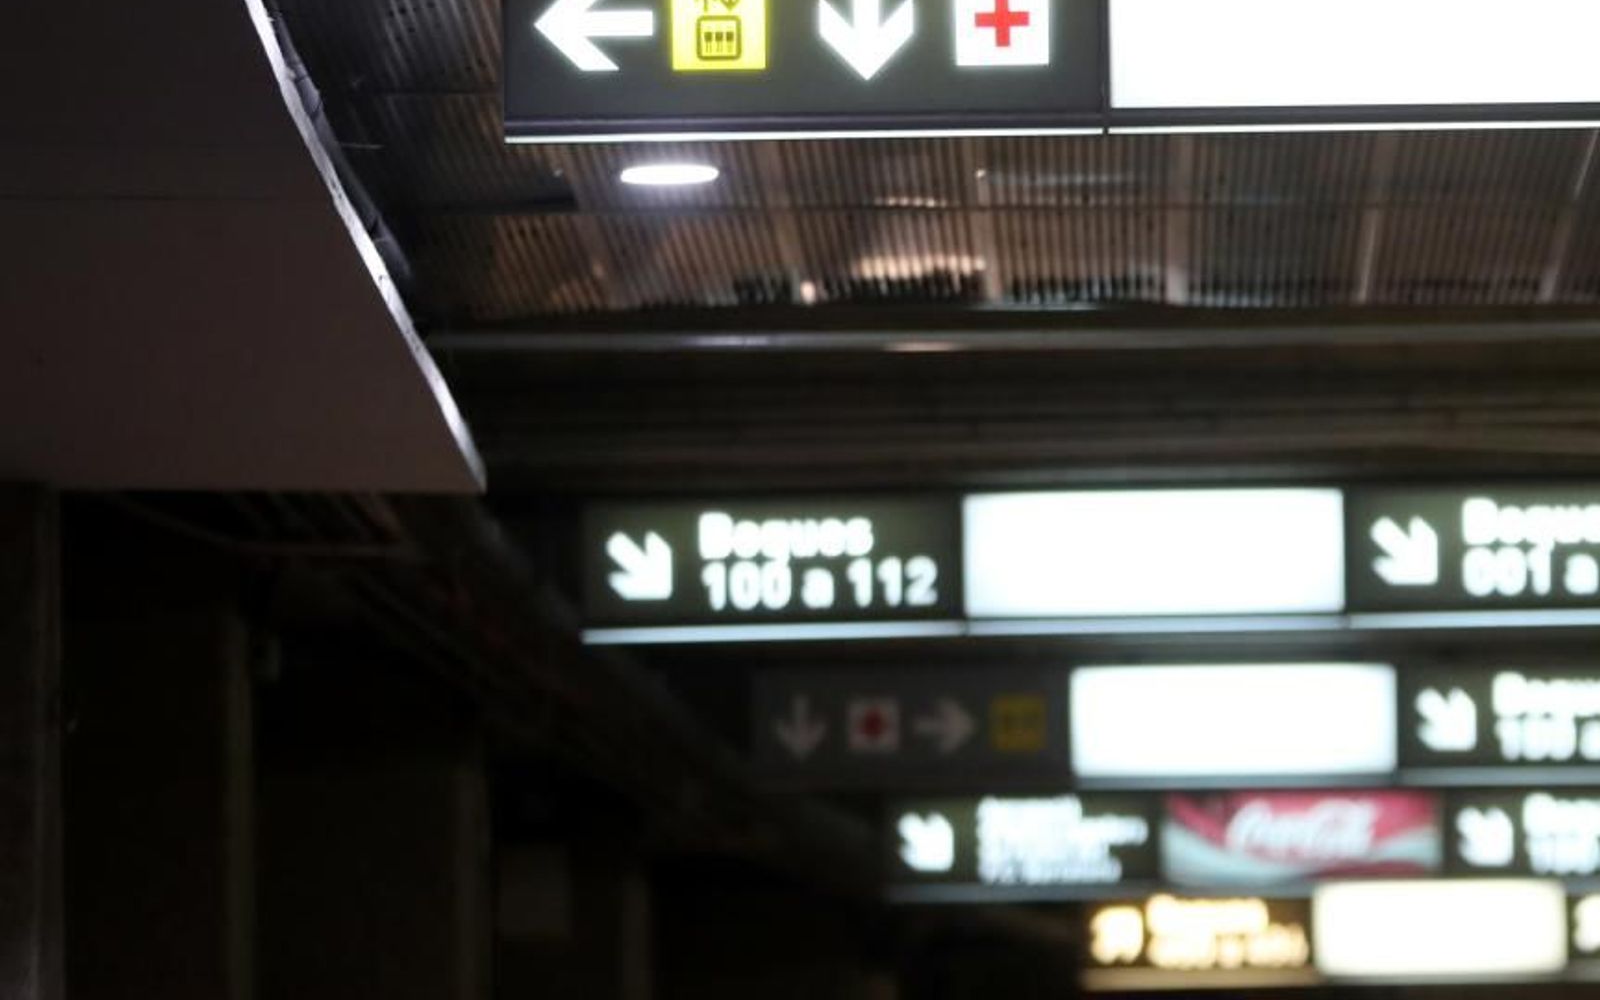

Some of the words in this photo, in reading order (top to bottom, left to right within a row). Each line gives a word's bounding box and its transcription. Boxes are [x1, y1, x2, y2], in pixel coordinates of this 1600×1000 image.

[702, 561, 792, 610] 100
[801, 568, 835, 608] a
[845, 556, 938, 607] 112
